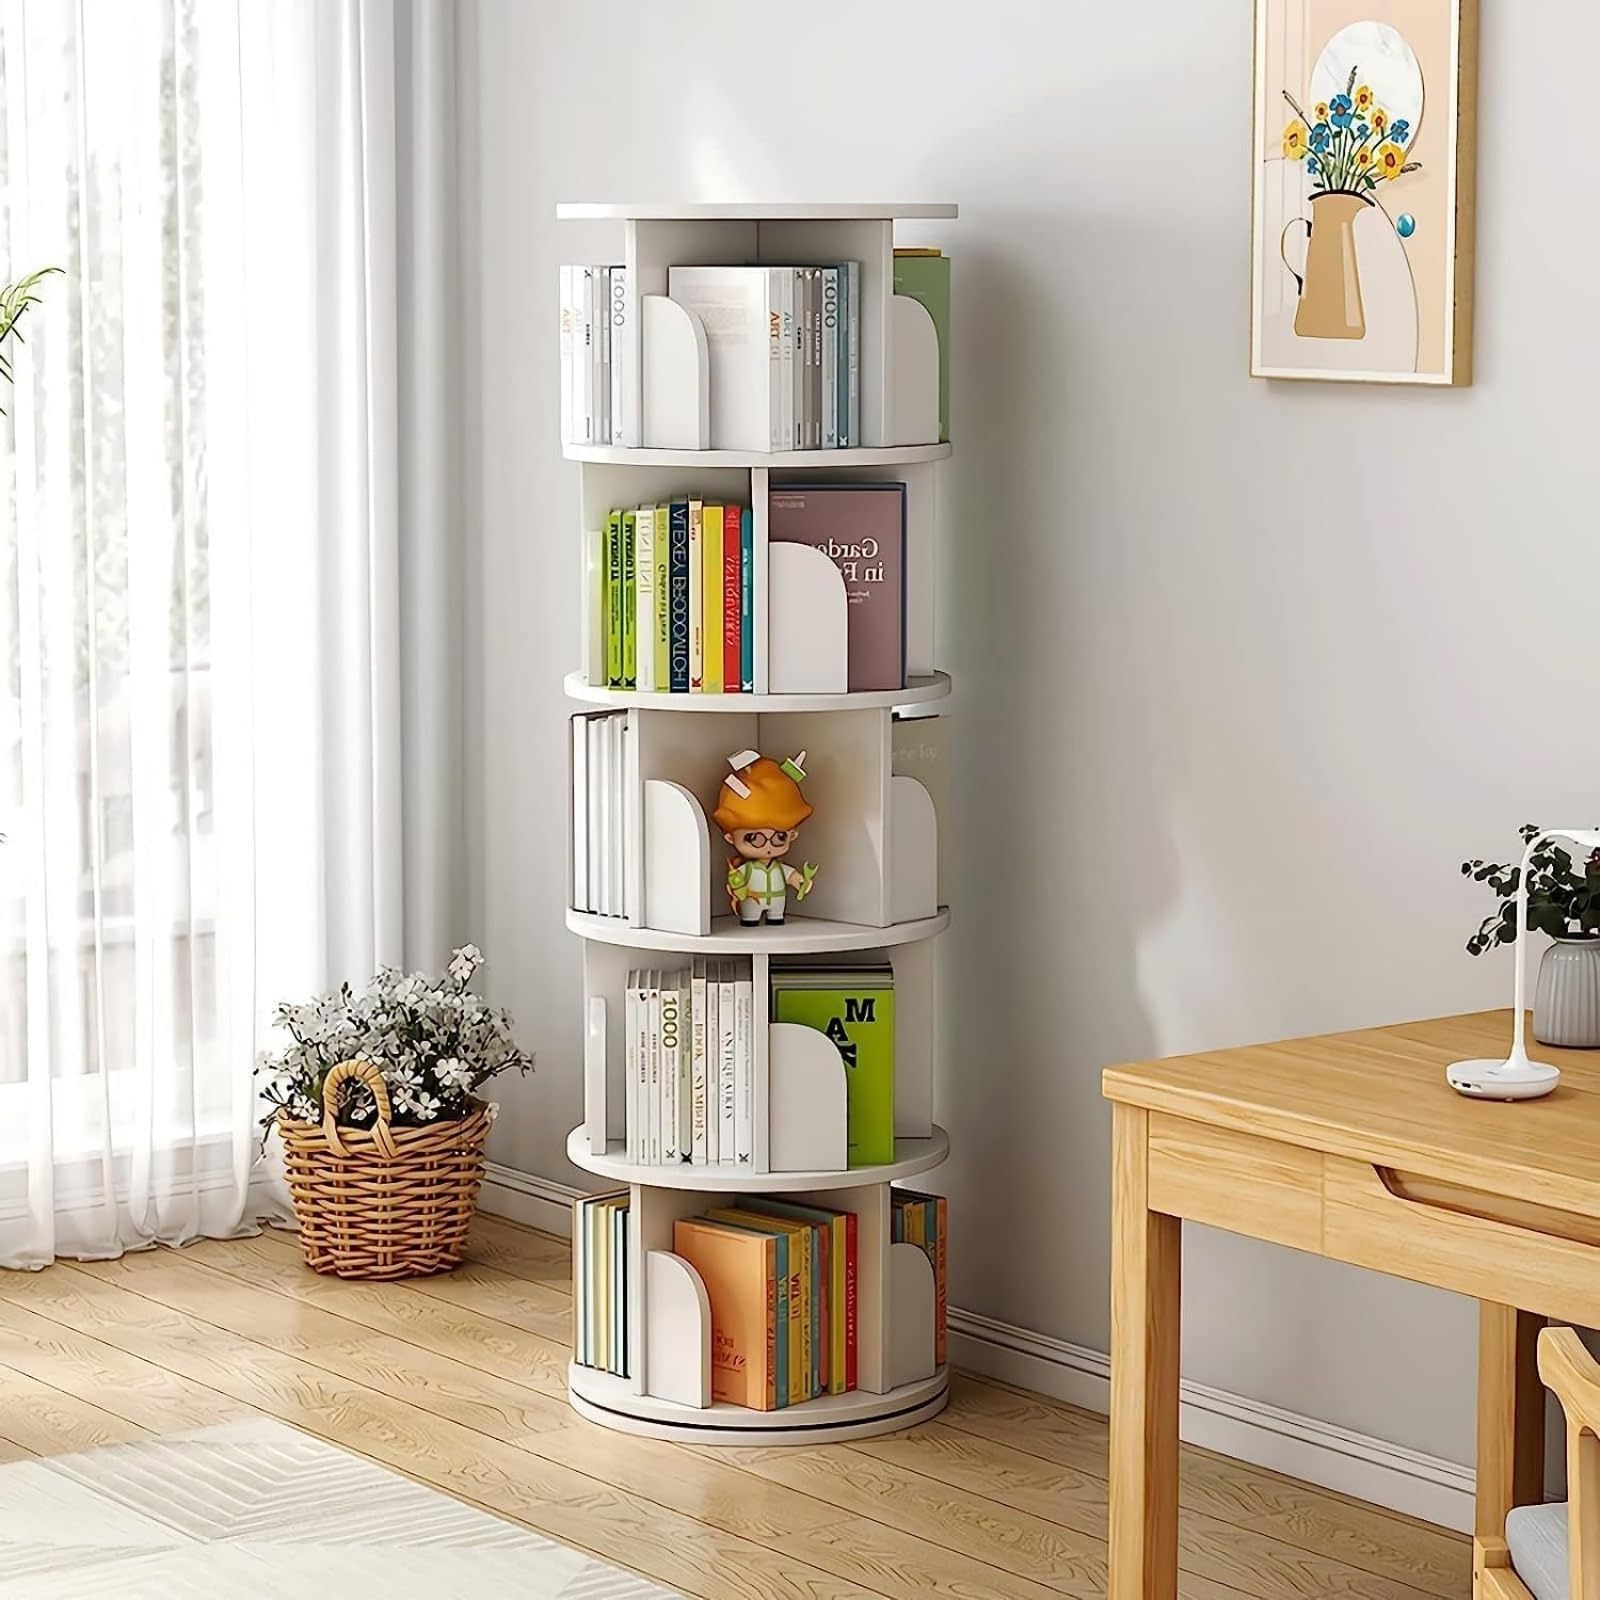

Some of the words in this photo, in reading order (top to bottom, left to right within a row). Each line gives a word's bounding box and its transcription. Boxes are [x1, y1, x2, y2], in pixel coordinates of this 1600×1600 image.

[613, 275, 625, 326] 1000
[769, 312, 781, 339] ART
[824, 276, 836, 328] 1000
[662, 997, 678, 1049] 1000
